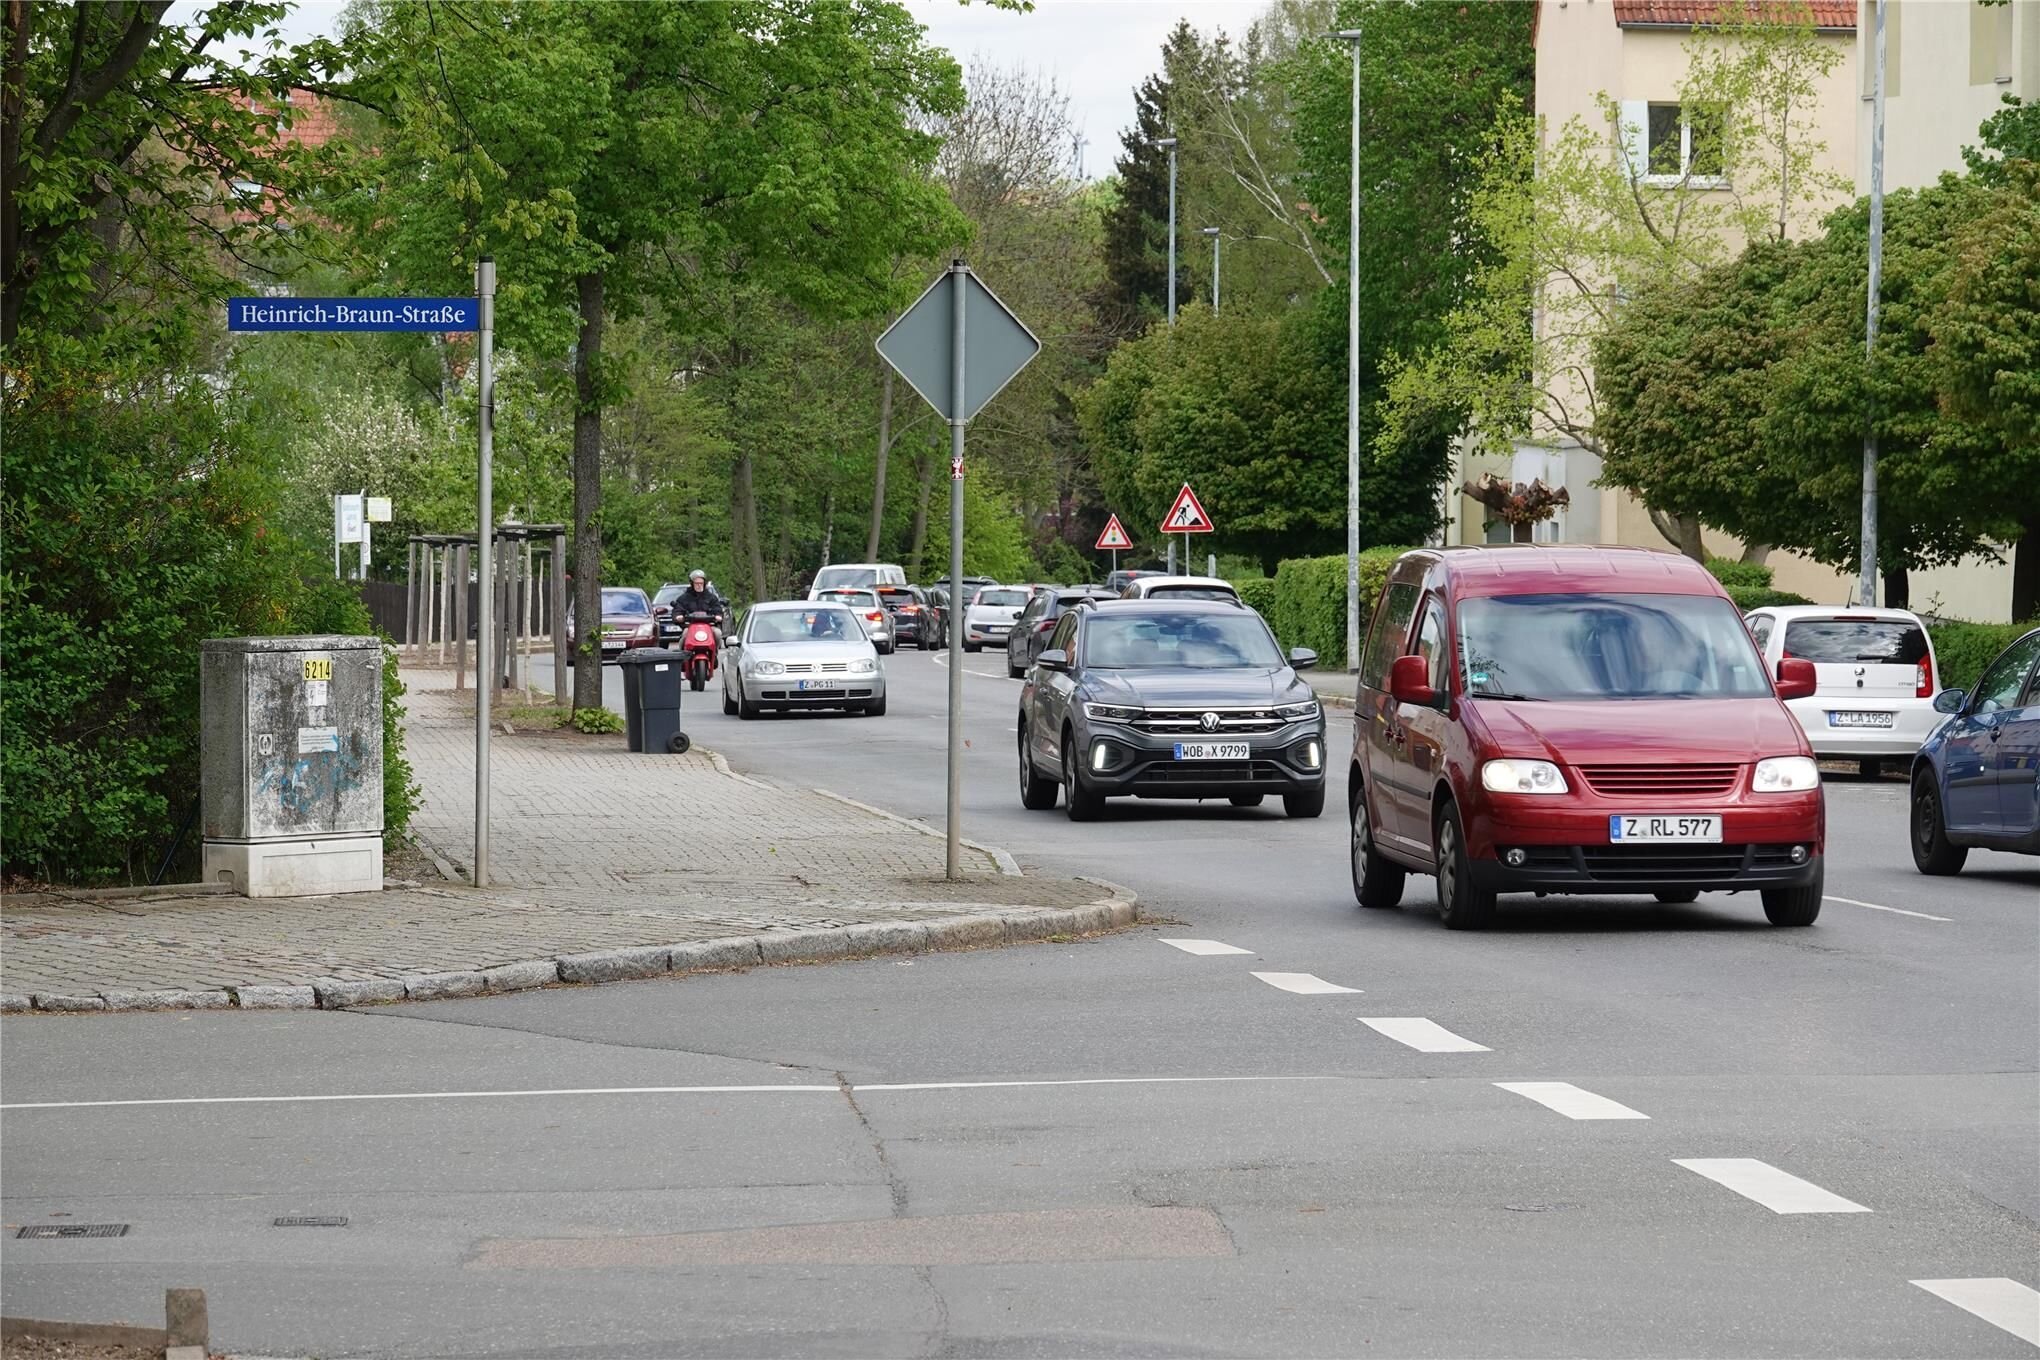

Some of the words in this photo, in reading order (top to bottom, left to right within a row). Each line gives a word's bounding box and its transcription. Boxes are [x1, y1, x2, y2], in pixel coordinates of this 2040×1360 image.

[241, 305, 465, 324] Heinrich-Braun-Straße
[305, 661, 330, 679] 6214
[804, 681, 810, 689] Z
[1837, 712, 1844, 723] Z
[1850, 712, 1864, 723] LA
[1866, 712, 1891, 724] 1956
[1182, 745, 1204, 758] WOB
[1211, 745, 1218, 758] X
[1220, 745, 1247, 758] 9799
[1626, 819, 1638, 836] Z
[1650, 819, 1674, 836] RL
[1679, 819, 1712, 836] 577
